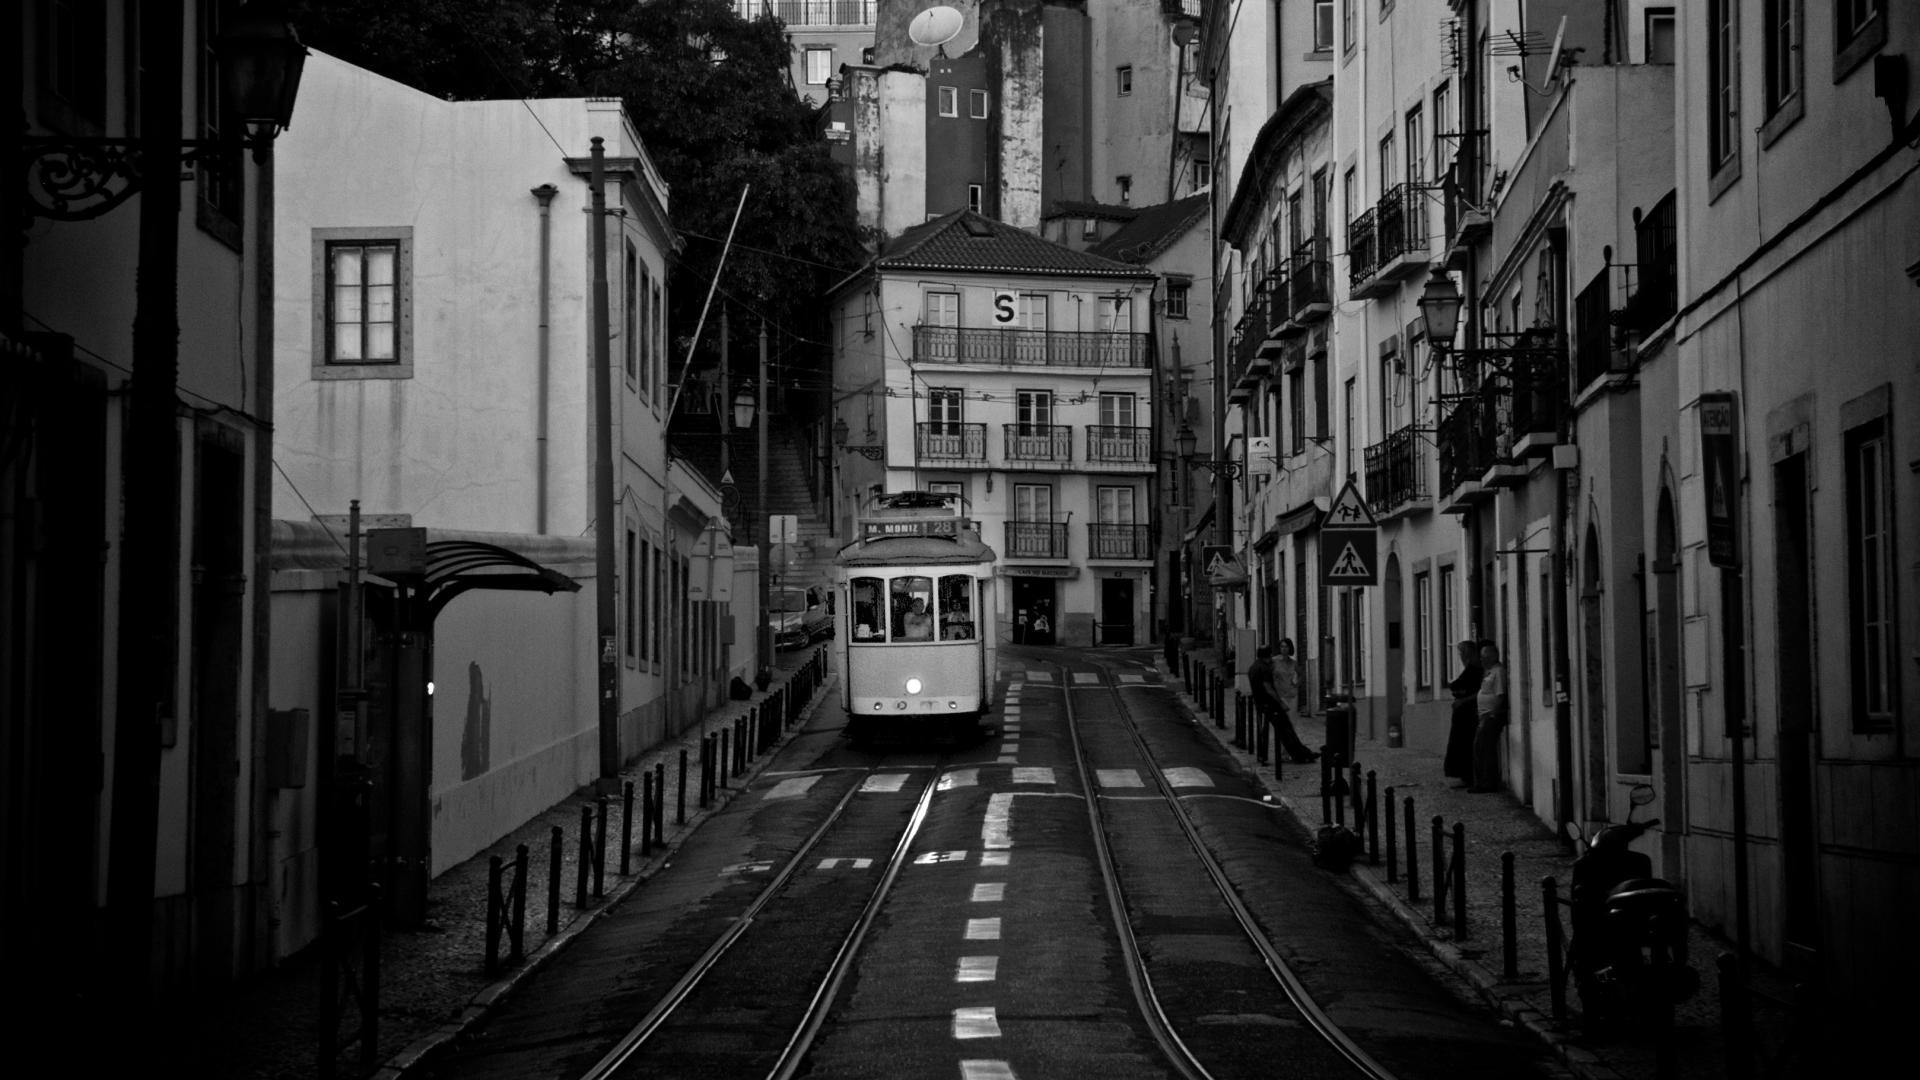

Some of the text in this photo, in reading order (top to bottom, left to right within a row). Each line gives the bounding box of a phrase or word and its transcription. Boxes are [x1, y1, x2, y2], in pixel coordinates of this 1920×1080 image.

[994, 294, 1014, 322] S
[868, 524, 918, 533] M. MONIZ
[934, 522, 951, 533] 28
